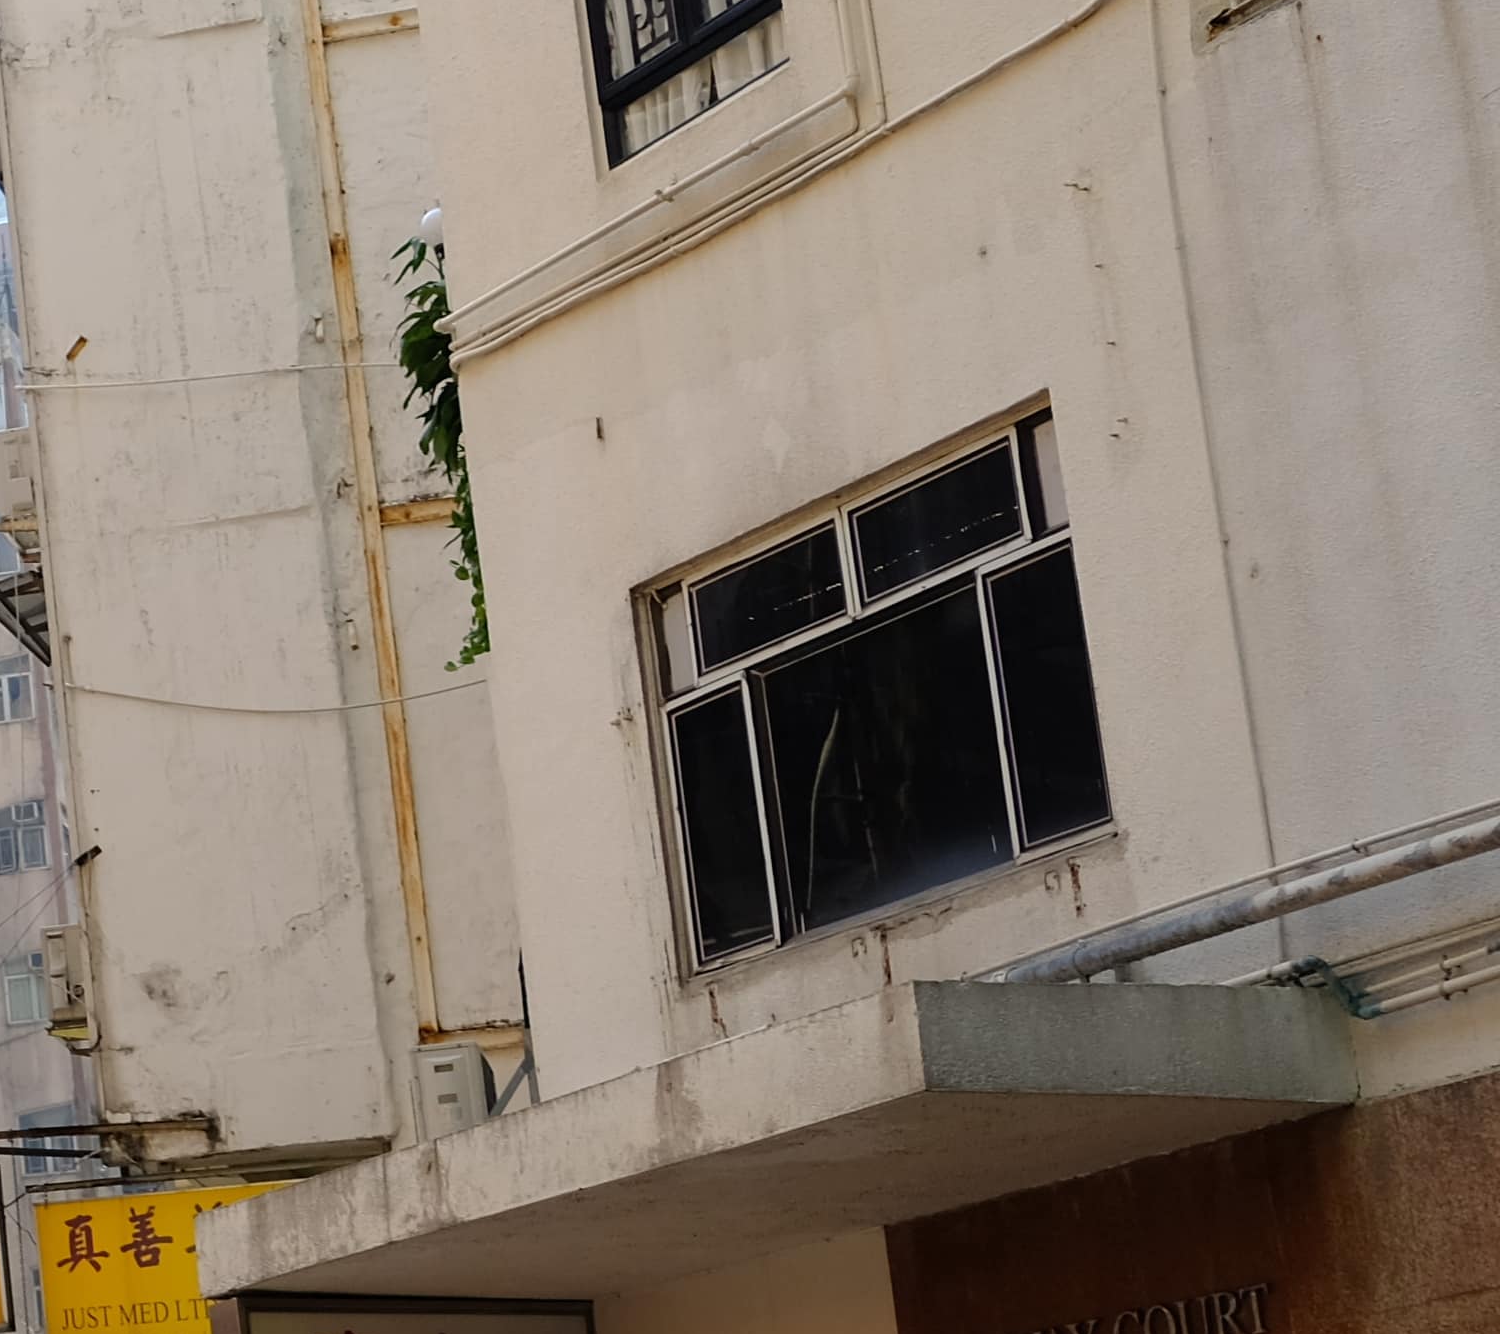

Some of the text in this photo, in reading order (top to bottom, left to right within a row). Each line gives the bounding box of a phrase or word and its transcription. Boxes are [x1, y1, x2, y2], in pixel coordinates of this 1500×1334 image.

[56, 1201, 224, 1273] 真善
[62, 1305, 112, 1331] JUST
[118, 1300, 170, 1327] MED
